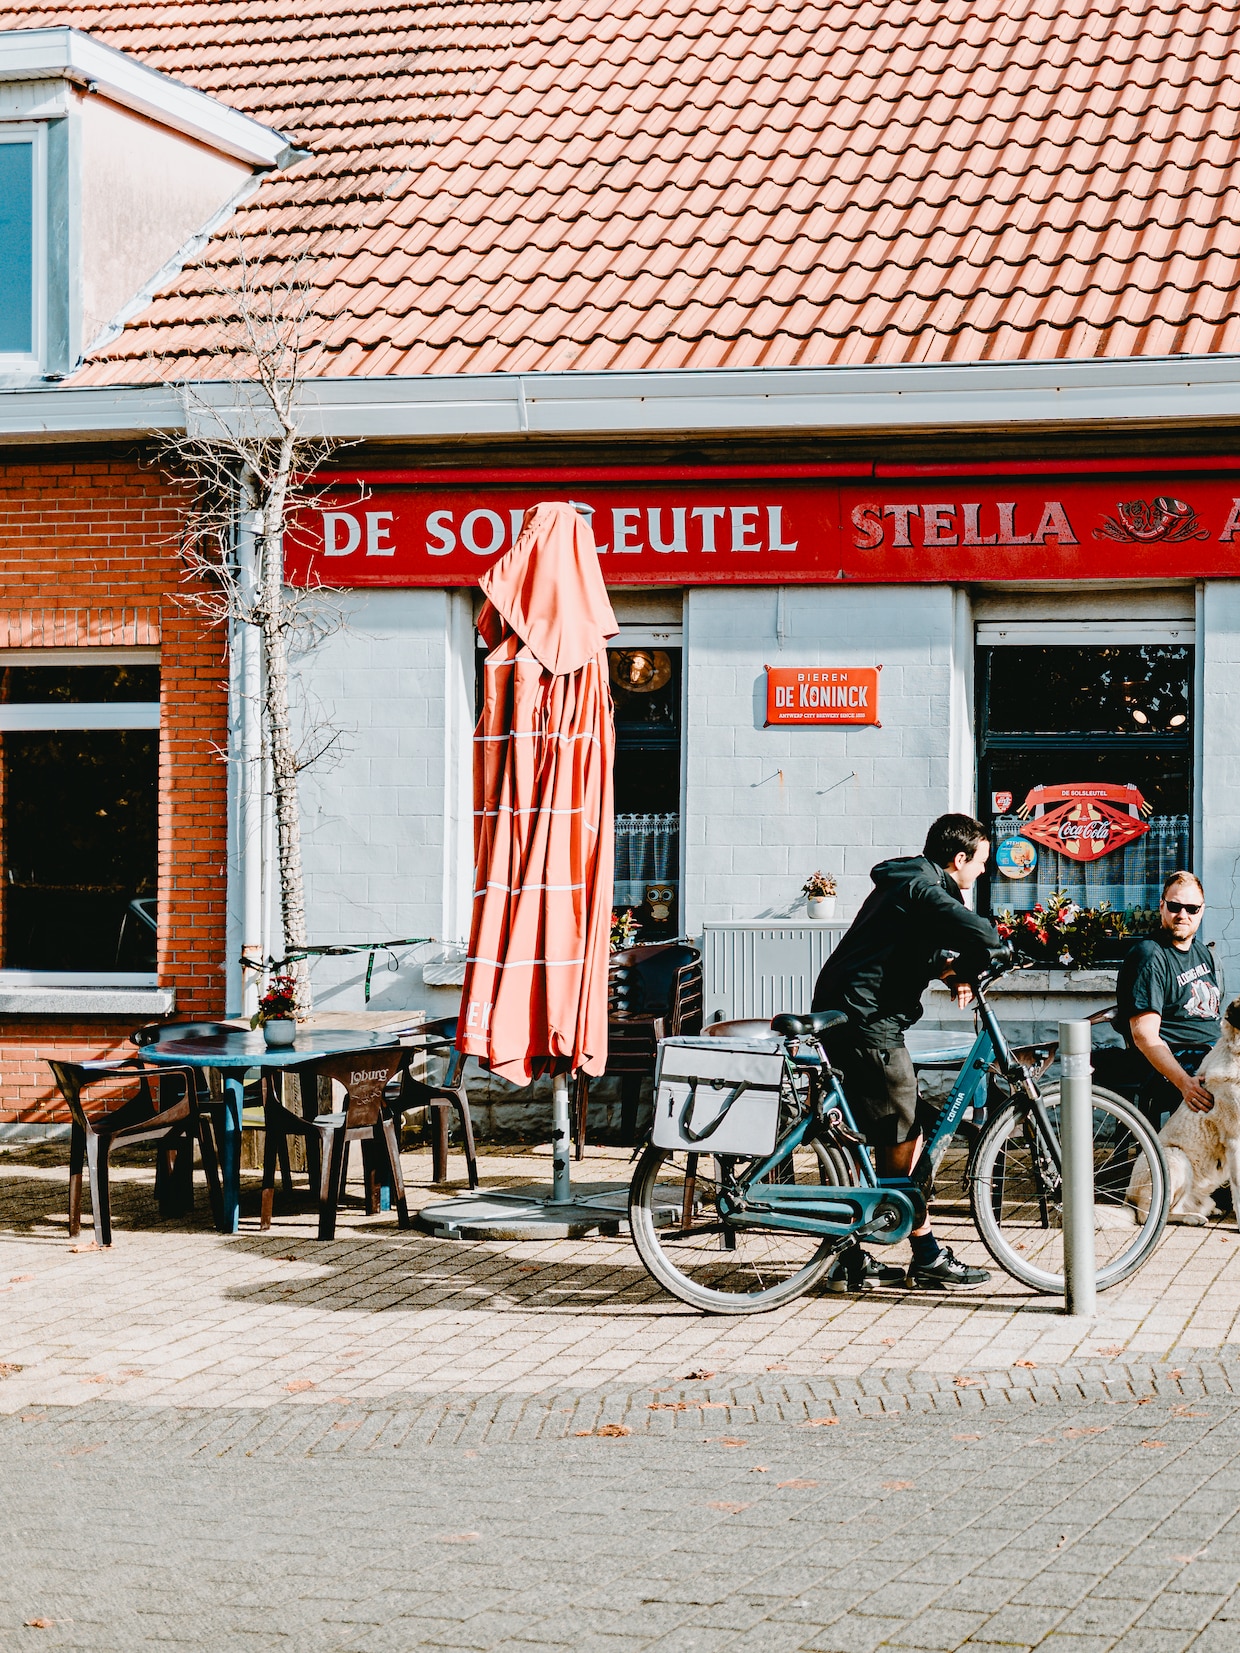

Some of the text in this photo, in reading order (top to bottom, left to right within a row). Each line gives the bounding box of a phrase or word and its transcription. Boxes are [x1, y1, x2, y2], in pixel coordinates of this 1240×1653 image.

[322, 511, 397, 557] DE
[850, 501, 1081, 549] STELLA
[797, 673, 849, 682] BIEREN
[775, 683, 869, 707] DE KONINCK
[350, 1068, 389, 1085] Loburg
